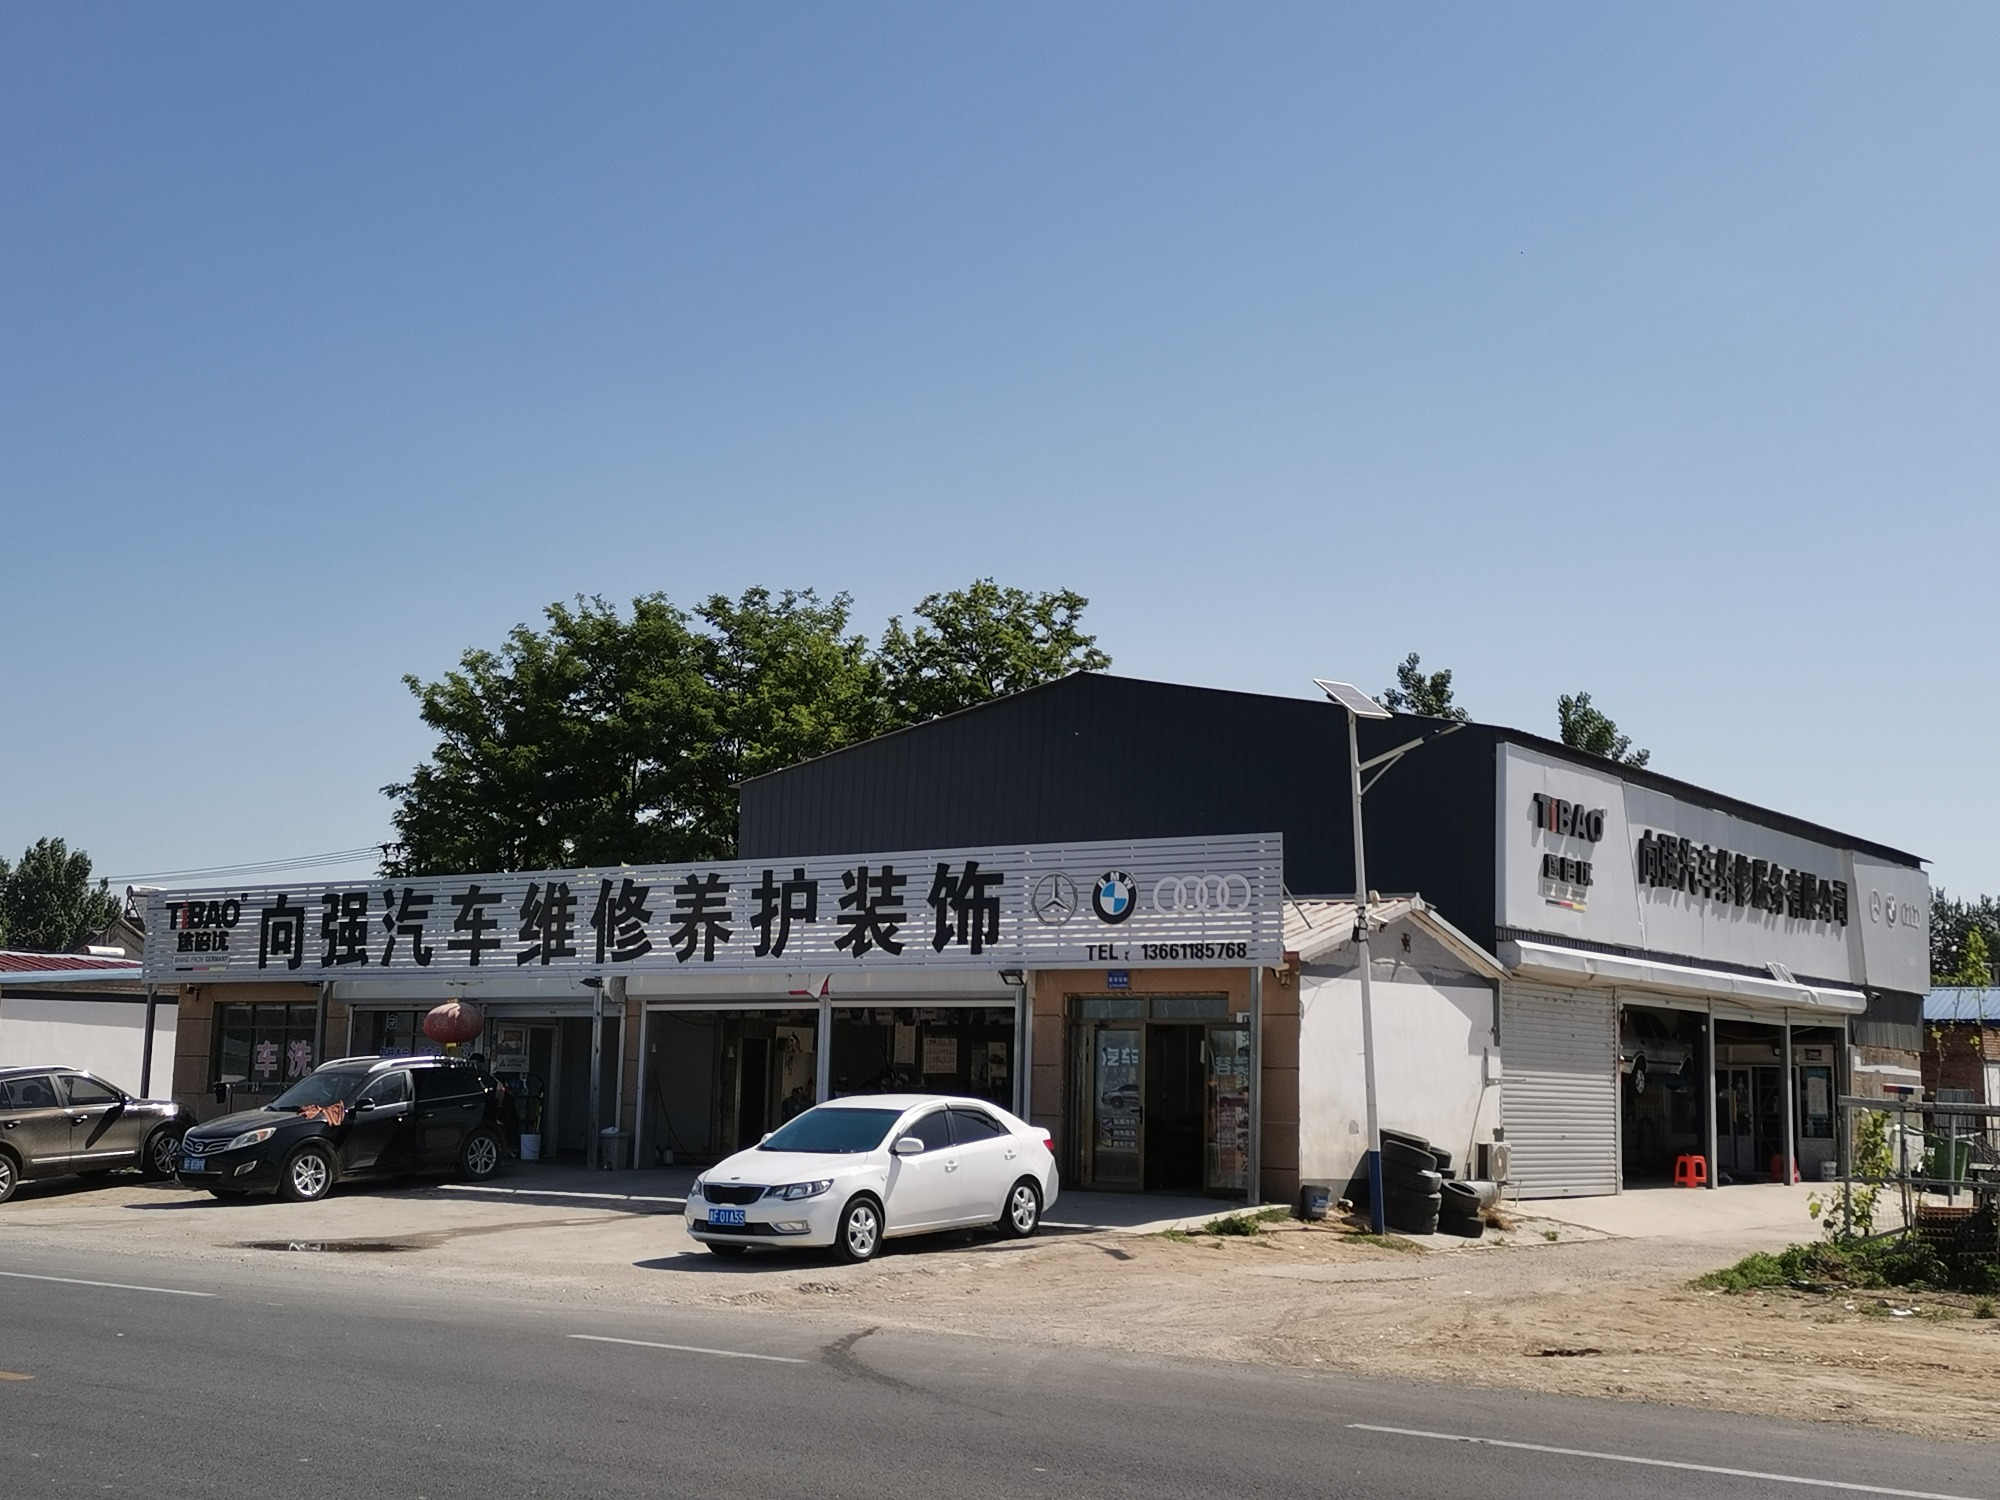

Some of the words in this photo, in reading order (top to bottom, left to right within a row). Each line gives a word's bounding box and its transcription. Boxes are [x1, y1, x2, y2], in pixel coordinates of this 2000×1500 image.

[258, 861, 1004, 970] 向强汽车维修养护装饰
[1141, 942, 1247, 960] 13661185768
